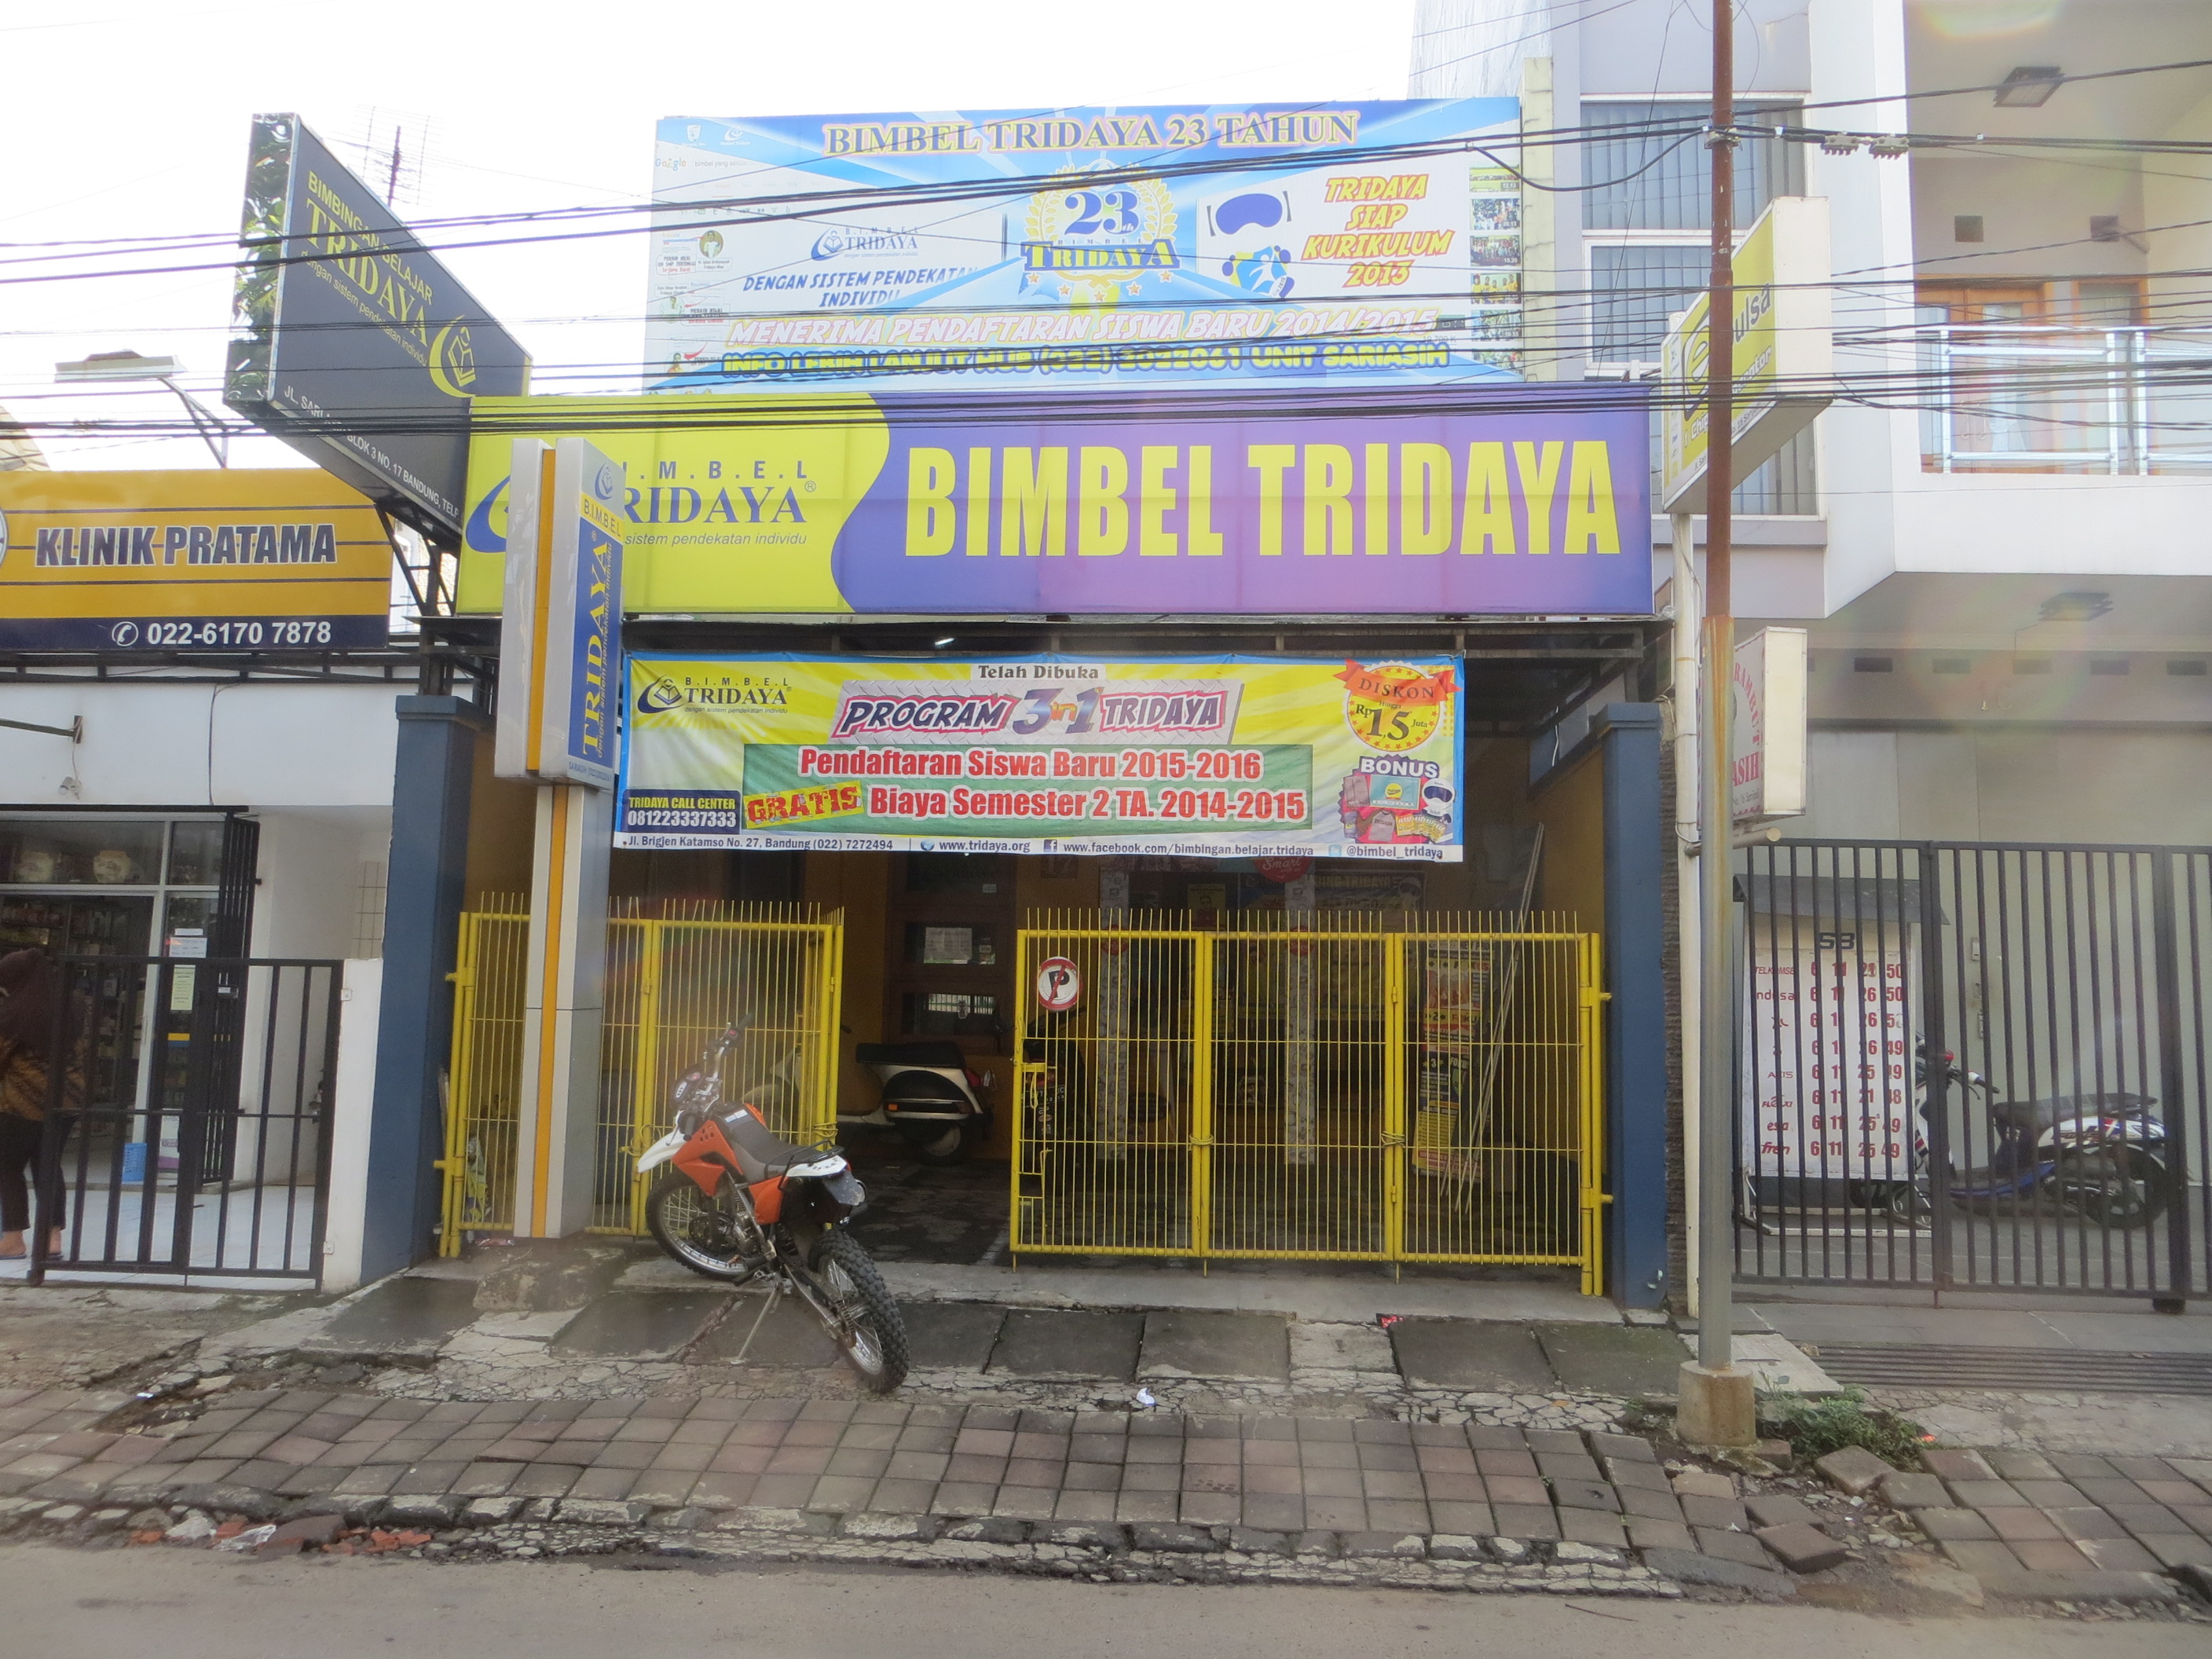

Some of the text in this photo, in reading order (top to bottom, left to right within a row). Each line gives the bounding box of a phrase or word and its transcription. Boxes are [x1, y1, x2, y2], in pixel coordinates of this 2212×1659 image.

[825, 112, 1359, 155] BIMBEL TRIDAYA 23 TAHUN
[1324, 174, 1429, 203] TRIDAYA
[1344, 204, 1409, 231] SIAP
[308, 170, 433, 306] BIMBINGAN BELAJAR
[844, 236, 918, 251] TRIDAYA
[1301, 230, 1456, 261] KURIKULUM
[1024, 240, 1177, 269] TRIDAYA
[306, 198, 428, 347] TRIDAYA
[742, 273, 810, 292] DENGAN
[810, 269, 871, 289] SISTEM
[1342, 260, 1415, 288] 2013
[333, 280, 359, 307] sistem
[1734, 281, 1772, 345] ulsa
[726, 306, 1442, 347] MENERIMA PENDAFTARAN SISWA BARU 2014/2015
[1250, 343, 1318, 369] UNIT
[1323, 342, 1451, 368] SARIASIH
[284, 385, 298, 405] JL.
[346, 434, 370, 456] BLOK
[371, 446, 377, 460] 3
[377, 450, 391, 471] NO.
[393, 463, 402, 478] 17
[402, 471, 441, 509] BANDUNG,
[905, 439, 1622, 558] BIMBEL TRIDAYA
[35, 522, 338, 567] KLINIK PRATAMA
[624, 531, 808, 548] sistem pendekatan individu
[147, 621, 331, 646] 022-6170 7878
[583, 541, 609, 756] TRIDAYA
[978, 665, 1099, 679] Telah Dibuka
[684, 687, 788, 705] TRIDAYA
[1358, 677, 1434, 699] DISKON
[838, 698, 1012, 735] PROGRAM
[1104, 696, 1219, 727] TRIDAYA
[1356, 703, 1371, 719] Rp
[1412, 719, 1428, 728] Juta
[1379, 700, 1402, 709] Hingga
[800, 749, 1262, 779] Pendaftaran Siswa Baru 2015-2016
[1361, 758, 1439, 778] BONUS
[628, 797, 736, 810] TRIDAYA CALL CENTER
[747, 786, 859, 825] GRATIS
[870, 787, 1306, 820] Biaya Semester 2 TA. 2014-2015
[628, 811, 737, 828] 081223337333
[628, 836, 893, 851] Jl. Brigjen Katamso No. 27, Bandung (022) 7272494
[939, 840, 1031, 854] www.tridaya.org
[1063, 842, 1314, 856] www.facebook.com/bimbingan.belajar.tridaya
[1346, 844, 1444, 860] @bimbel_tridaya
[1811, 1064, 1821, 1080] 6
[1811, 1090, 1821, 1105] 6
[1811, 1115, 1822, 1130] 6
[1810, 1141, 1821, 1157] 6
[1828, 1141, 1843, 1156] 11
